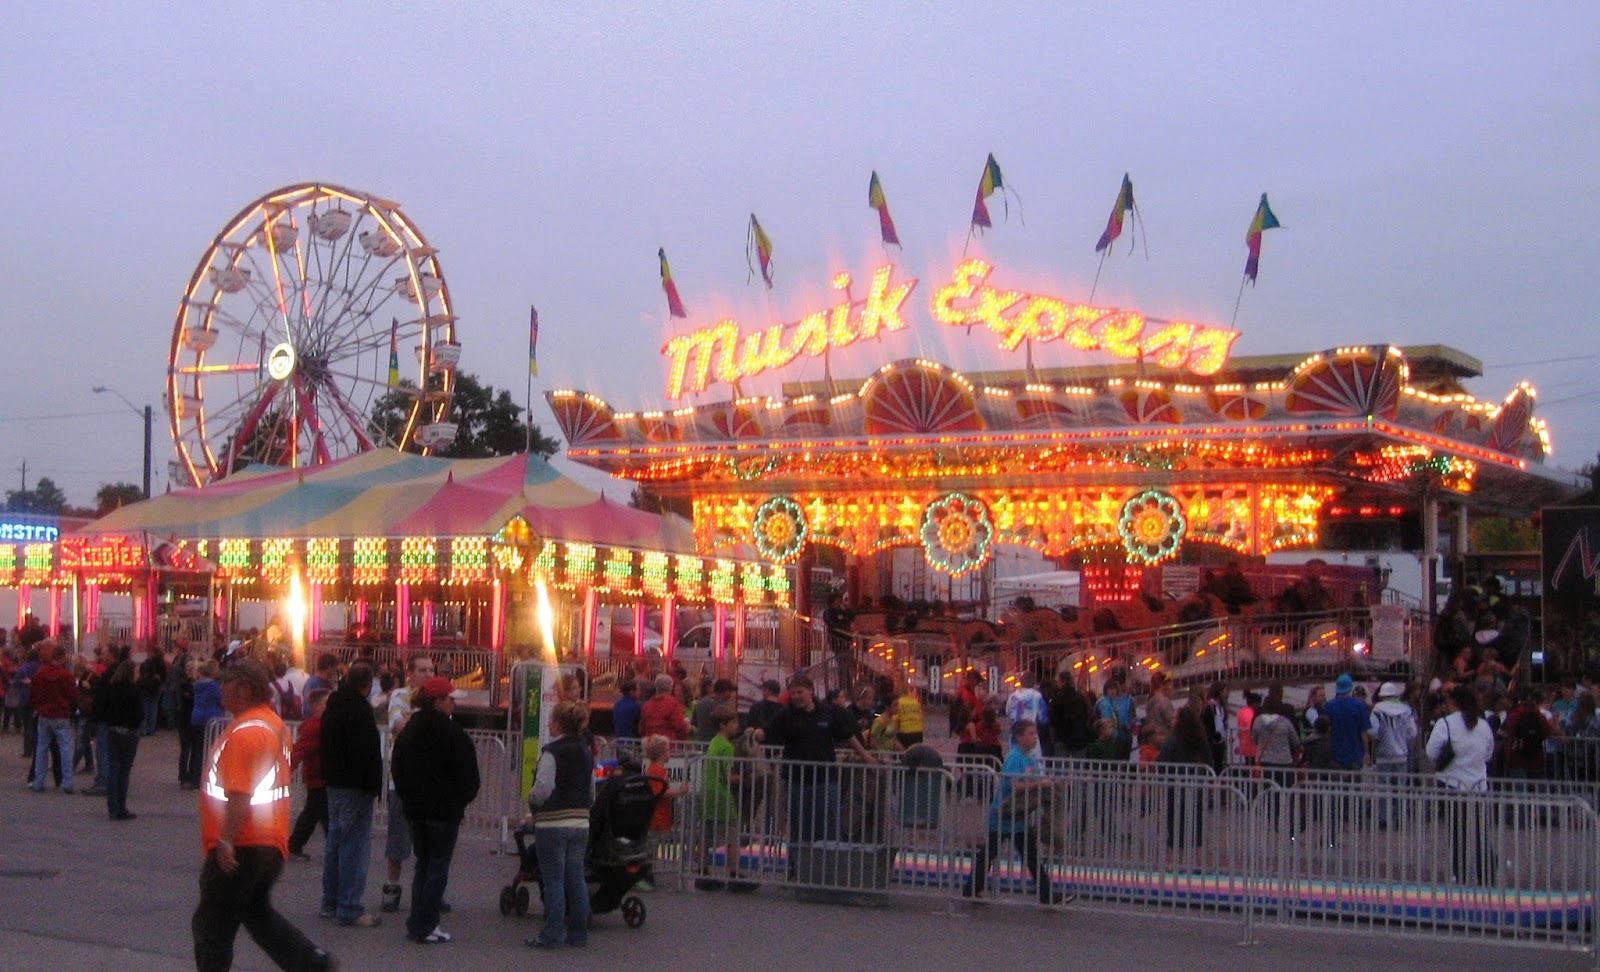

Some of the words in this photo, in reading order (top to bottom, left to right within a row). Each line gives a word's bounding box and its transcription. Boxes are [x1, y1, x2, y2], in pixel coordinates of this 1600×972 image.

[662, 263, 917, 399] Musik
[930, 258, 1241, 377] Express
[0, 523, 59, 541] NSTER
